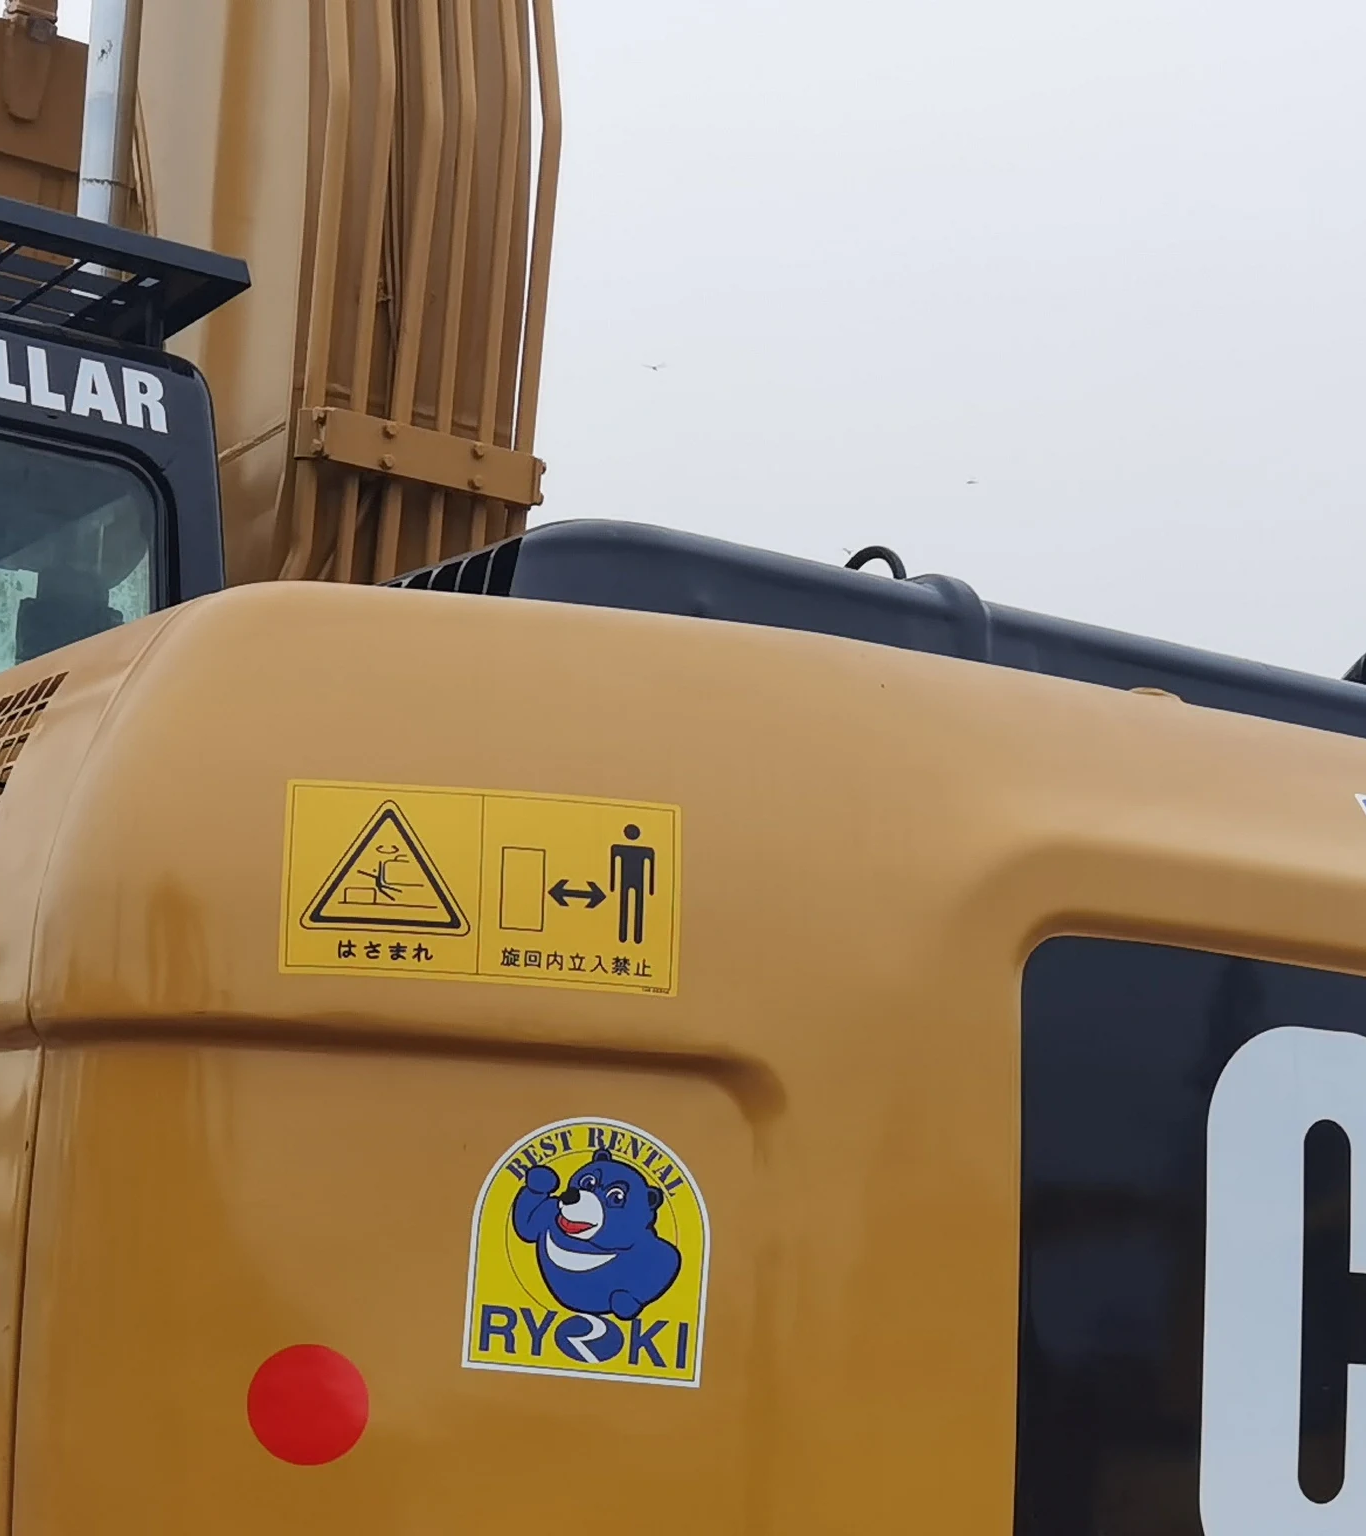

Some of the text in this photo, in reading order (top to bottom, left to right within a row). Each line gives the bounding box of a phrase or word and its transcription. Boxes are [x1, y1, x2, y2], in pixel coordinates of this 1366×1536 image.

[337, 939, 434, 963] はさまれ
[500, 946, 653, 978] 旋回内立入禁止
[505, 1127, 684, 1198] BEST RENTAL
